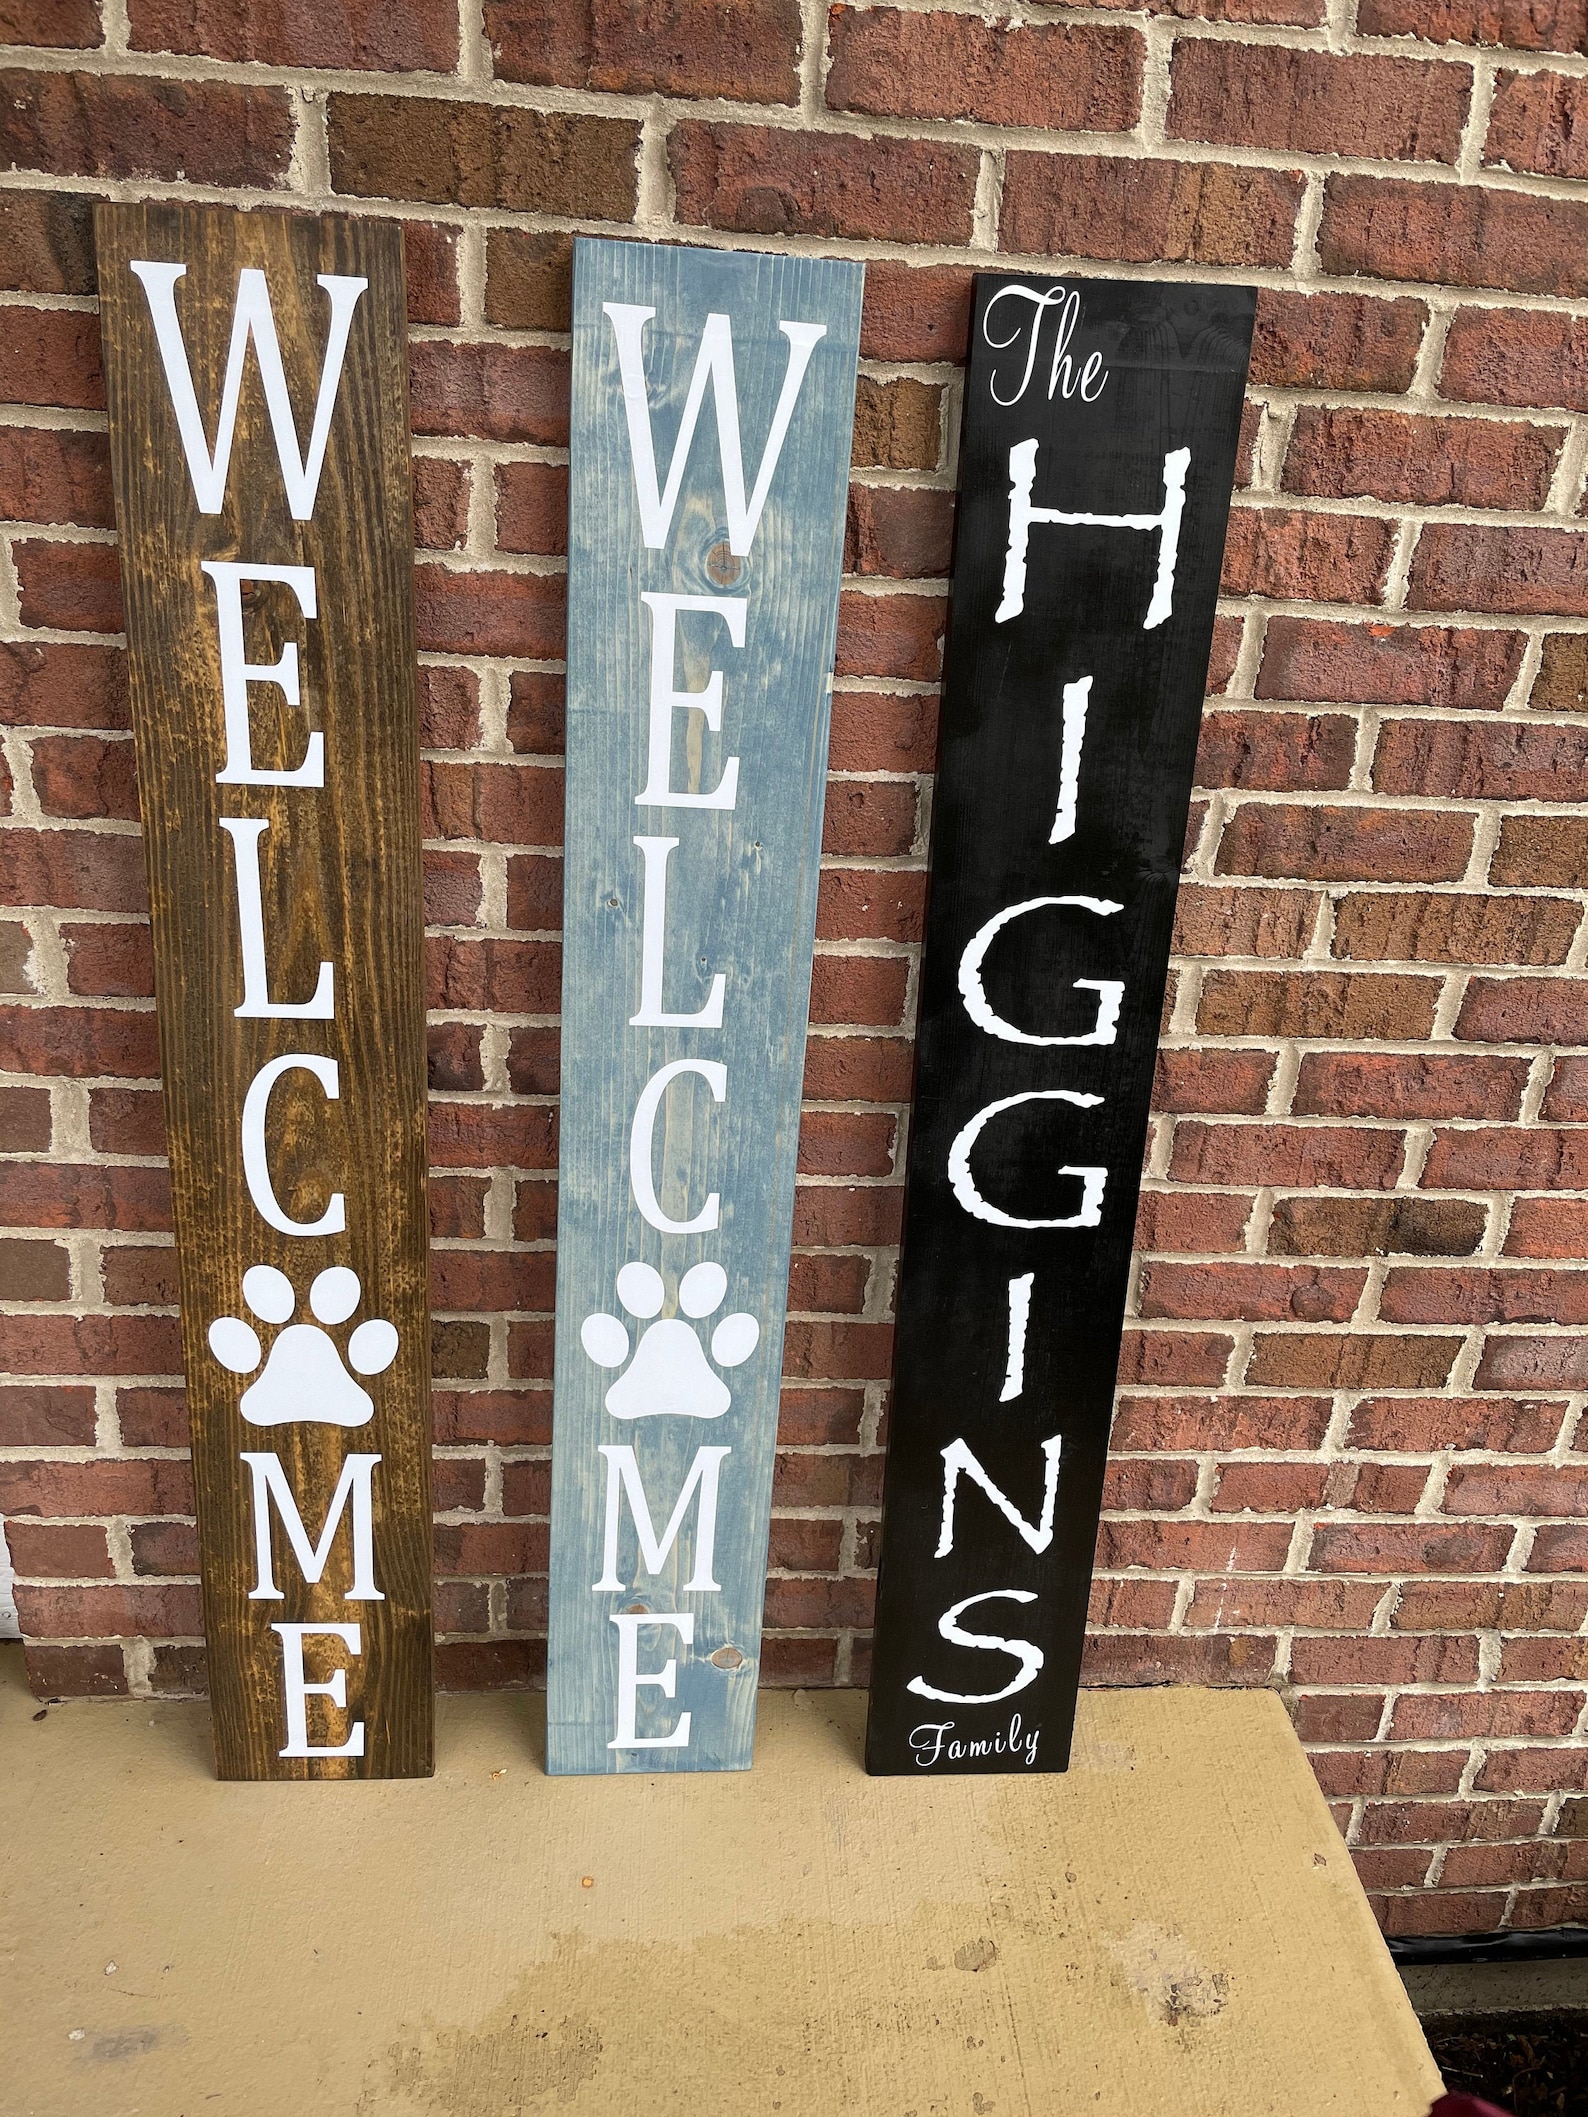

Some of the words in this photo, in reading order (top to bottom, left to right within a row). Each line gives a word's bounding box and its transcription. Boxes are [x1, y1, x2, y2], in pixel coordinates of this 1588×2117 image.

[983, 284, 1109, 407] The
[906, 437, 1192, 1705] HIGGINS
[908, 1713, 1041, 1767] Family
